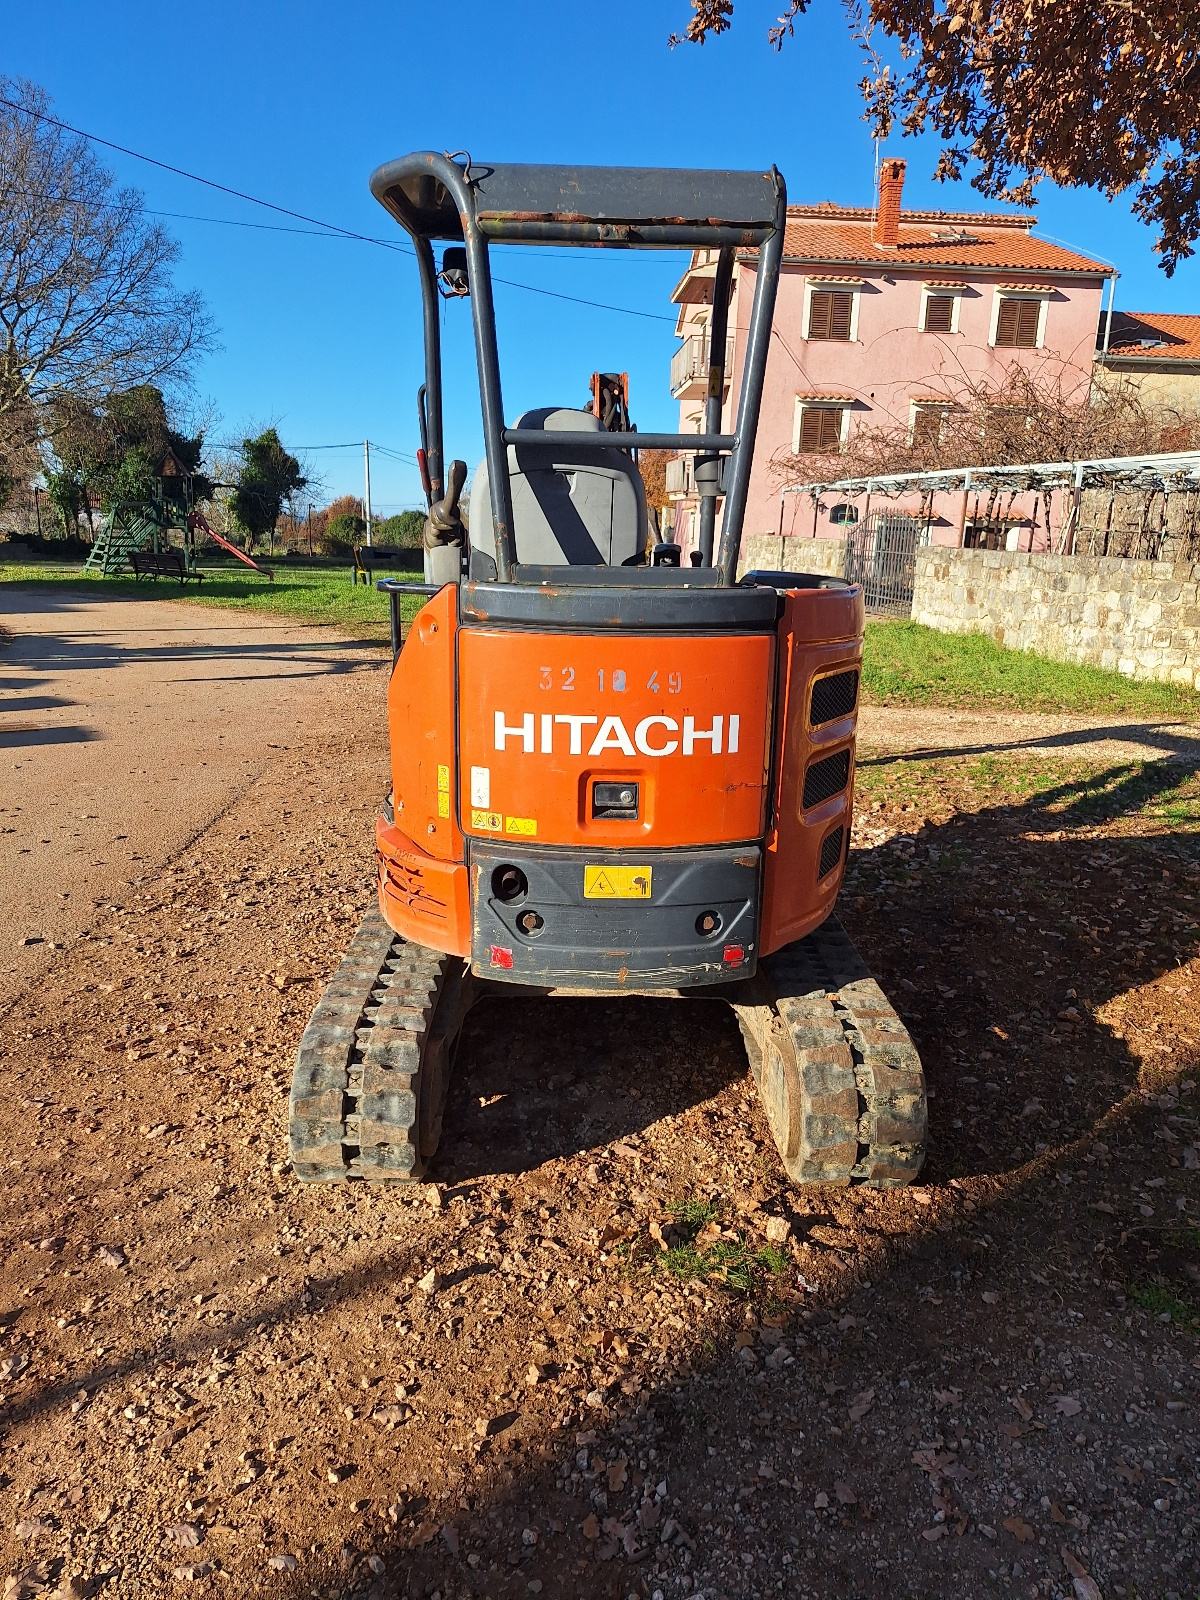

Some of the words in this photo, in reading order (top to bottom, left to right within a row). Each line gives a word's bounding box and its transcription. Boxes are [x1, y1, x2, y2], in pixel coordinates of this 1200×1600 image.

[539, 666, 575, 691] 32
[646, 671, 682, 694] 49
[494, 711, 740, 757] HITACHI
